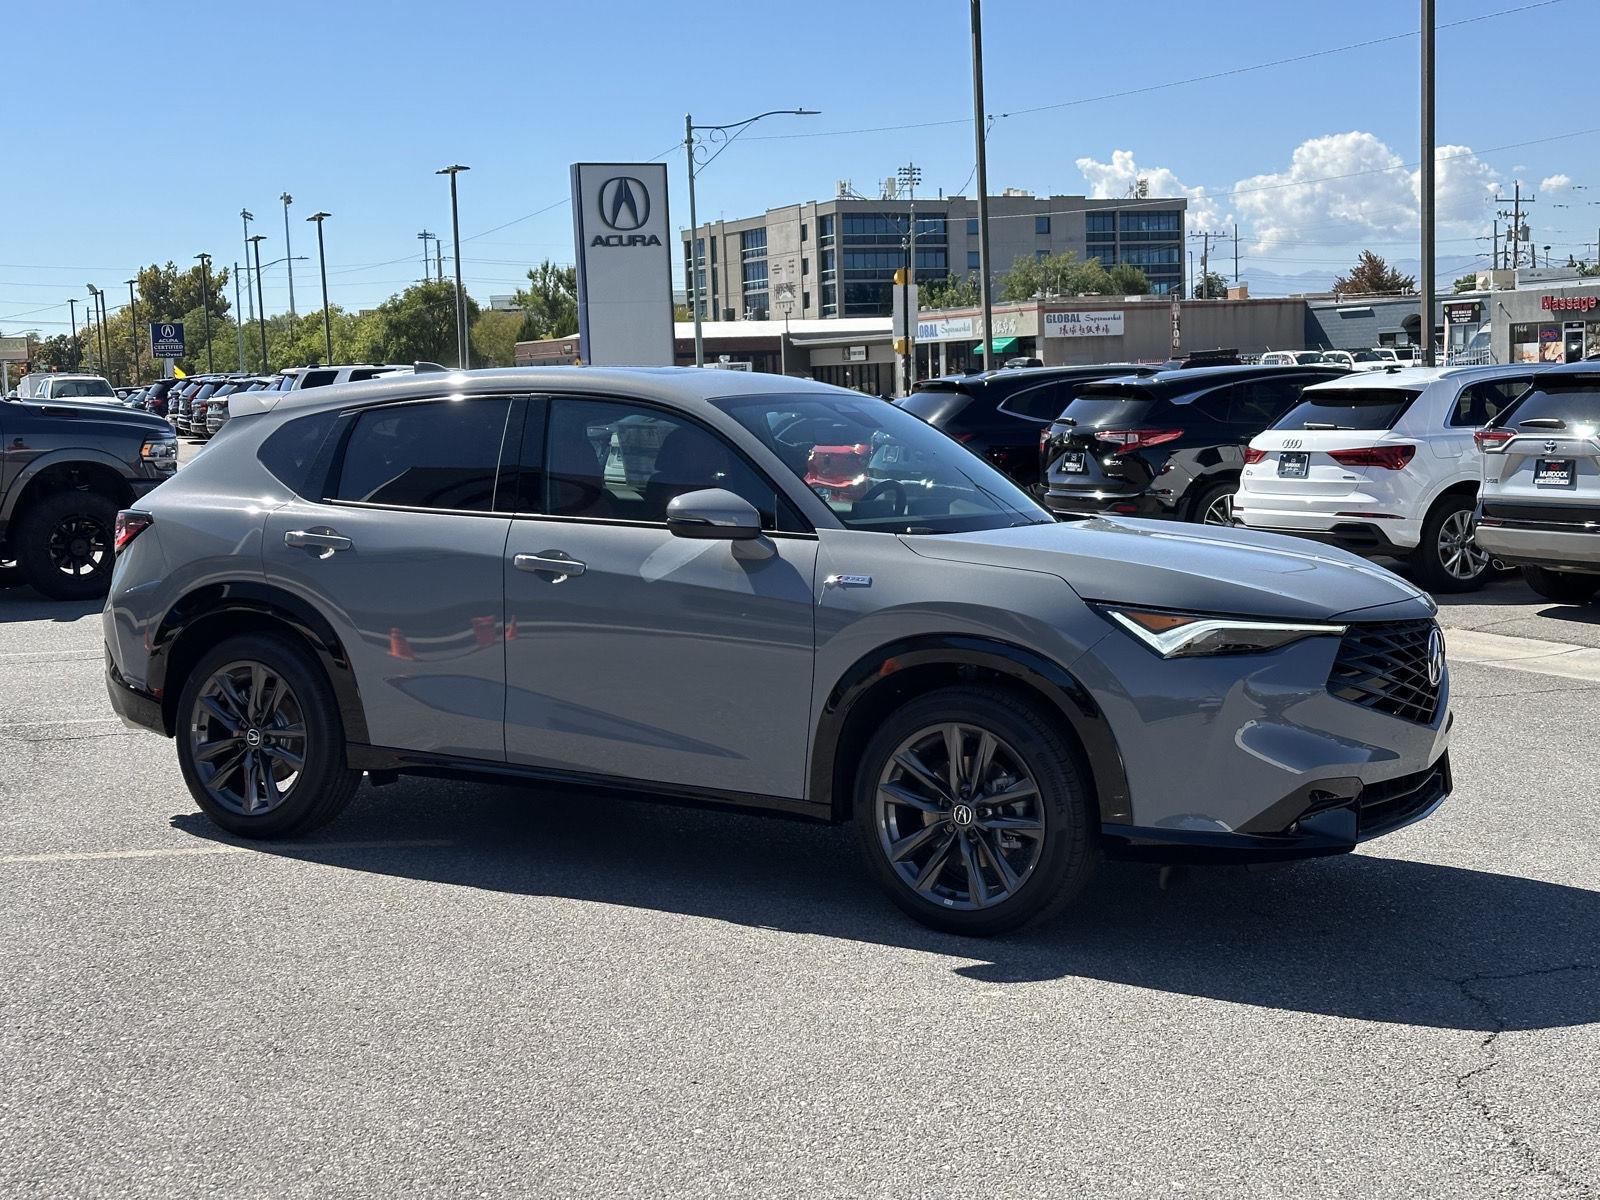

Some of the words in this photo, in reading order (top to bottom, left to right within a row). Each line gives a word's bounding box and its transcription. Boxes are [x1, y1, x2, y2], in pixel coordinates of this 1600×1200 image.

[590, 234, 662, 248] ACURA
[1541, 295, 1596, 312] Massage
[1045, 313, 1081, 324] GLOBAL
[917, 324, 939, 338] OBAL
[1539, 470, 1569, 478] MURDOCK
